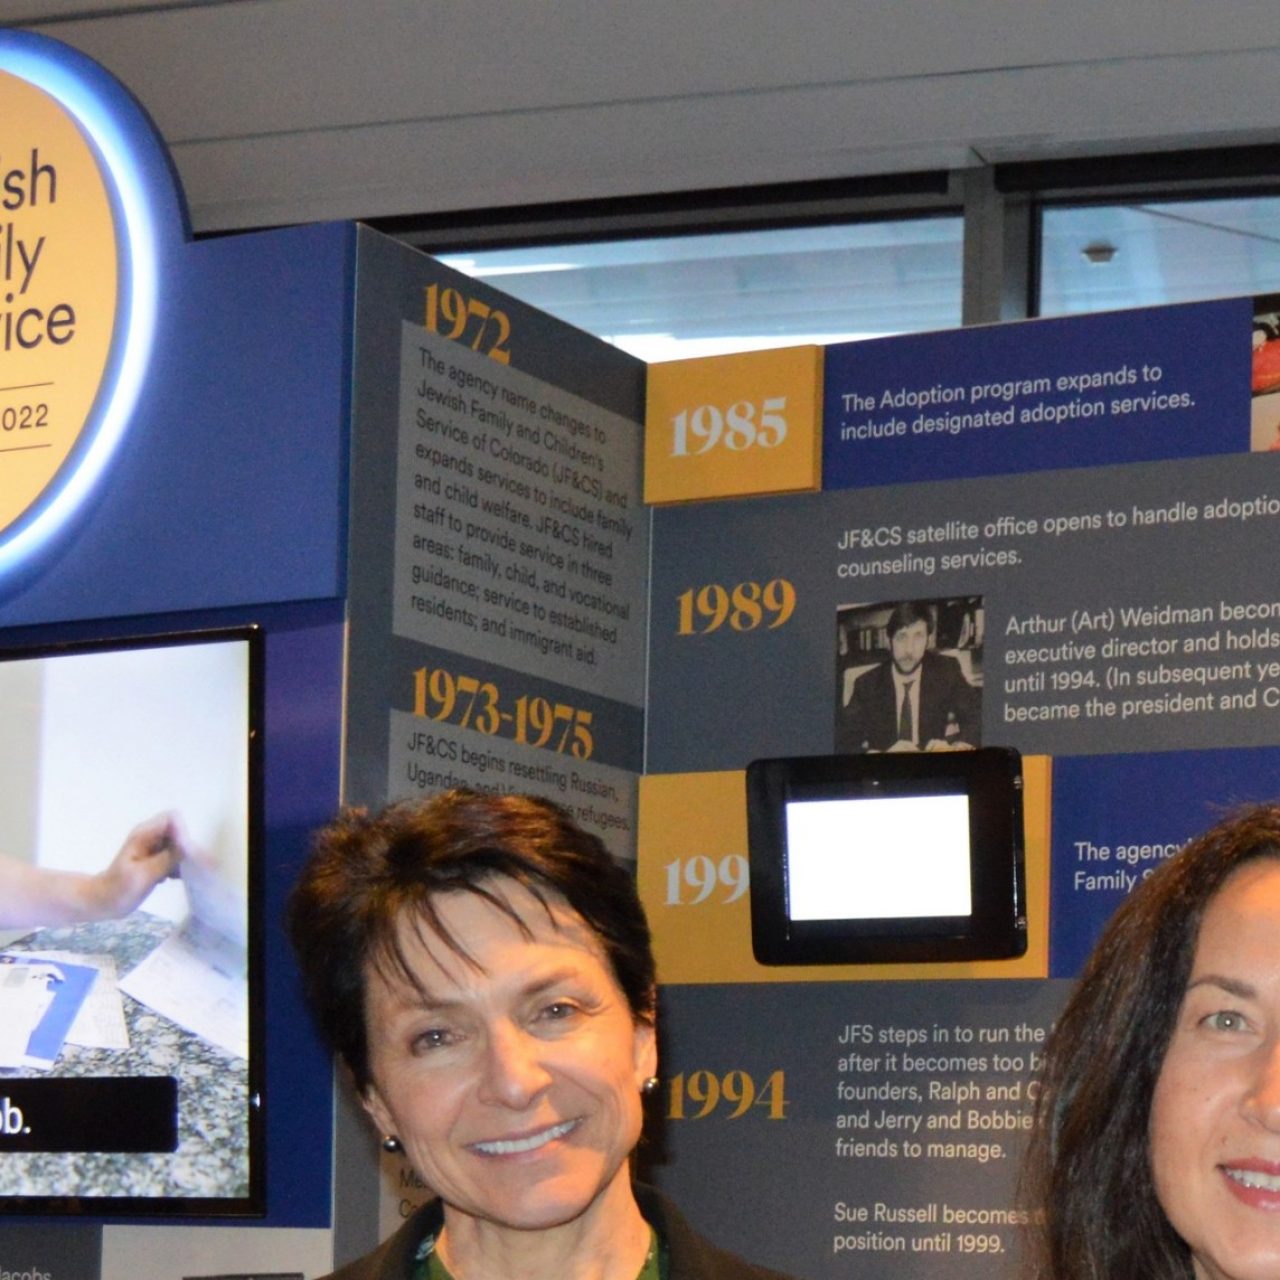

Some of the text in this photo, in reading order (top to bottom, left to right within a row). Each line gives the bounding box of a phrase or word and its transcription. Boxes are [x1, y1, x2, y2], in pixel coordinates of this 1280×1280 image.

[424, 283, 511, 366] 1972
[842, 364, 1162, 412] The Adoption program expands to
[670, 397, 788, 457] 1985
[841, 390, 1194, 440] include designated adoption services.
[838, 525, 901, 550] JF&CS
[907, 520, 978, 545] satellite
[984, 516, 1037, 538] office
[1044, 514, 1101, 536] opens
[1107, 510, 1126, 527] to
[1133, 501, 1198, 525] handle
[838, 547, 1021, 578] counseling services.
[676, 578, 796, 636] 1989
[1006, 614, 1066, 635] Arthur
[1072, 607, 1114, 634] (Art)
[1121, 604, 1213, 628] Weidman
[1005, 640, 1095, 664] executive
[1102, 637, 1178, 658] director
[1184, 631, 1220, 653] and
[1226, 627, 1280, 650] holds
[1005, 671, 1044, 693] until
[1051, 669, 1099, 690] 1994.
[1106, 665, 1130, 690] (In
[1137, 660, 1251, 686] subsequent
[412, 666, 594, 762] 1973-1975
[1004, 702, 1080, 722] became
[1086, 696, 1116, 717] the
[1122, 692, 1214, 719] president
[1220, 687, 1256, 710] and
[1074, 842, 1110, 861] The
[662, 854, 750, 905] 199
[1074, 870, 1137, 893] Family
[839, 1022, 1045, 1047] JFS steps in to run the
[838, 1052, 1024, 1072] after it becomes too
[666, 1069, 791, 1120] 1994
[838, 1080, 1021, 1105] founders, Ralph and
[837, 1109, 1032, 1133] and Jerry and Bobbie
[836, 1137, 1005, 1163] friends to manage.
[834, 1202, 868, 1222] Sue
[874, 1203, 938, 1223] Russell
[834, 1232, 1004, 1253] position until 1999.
